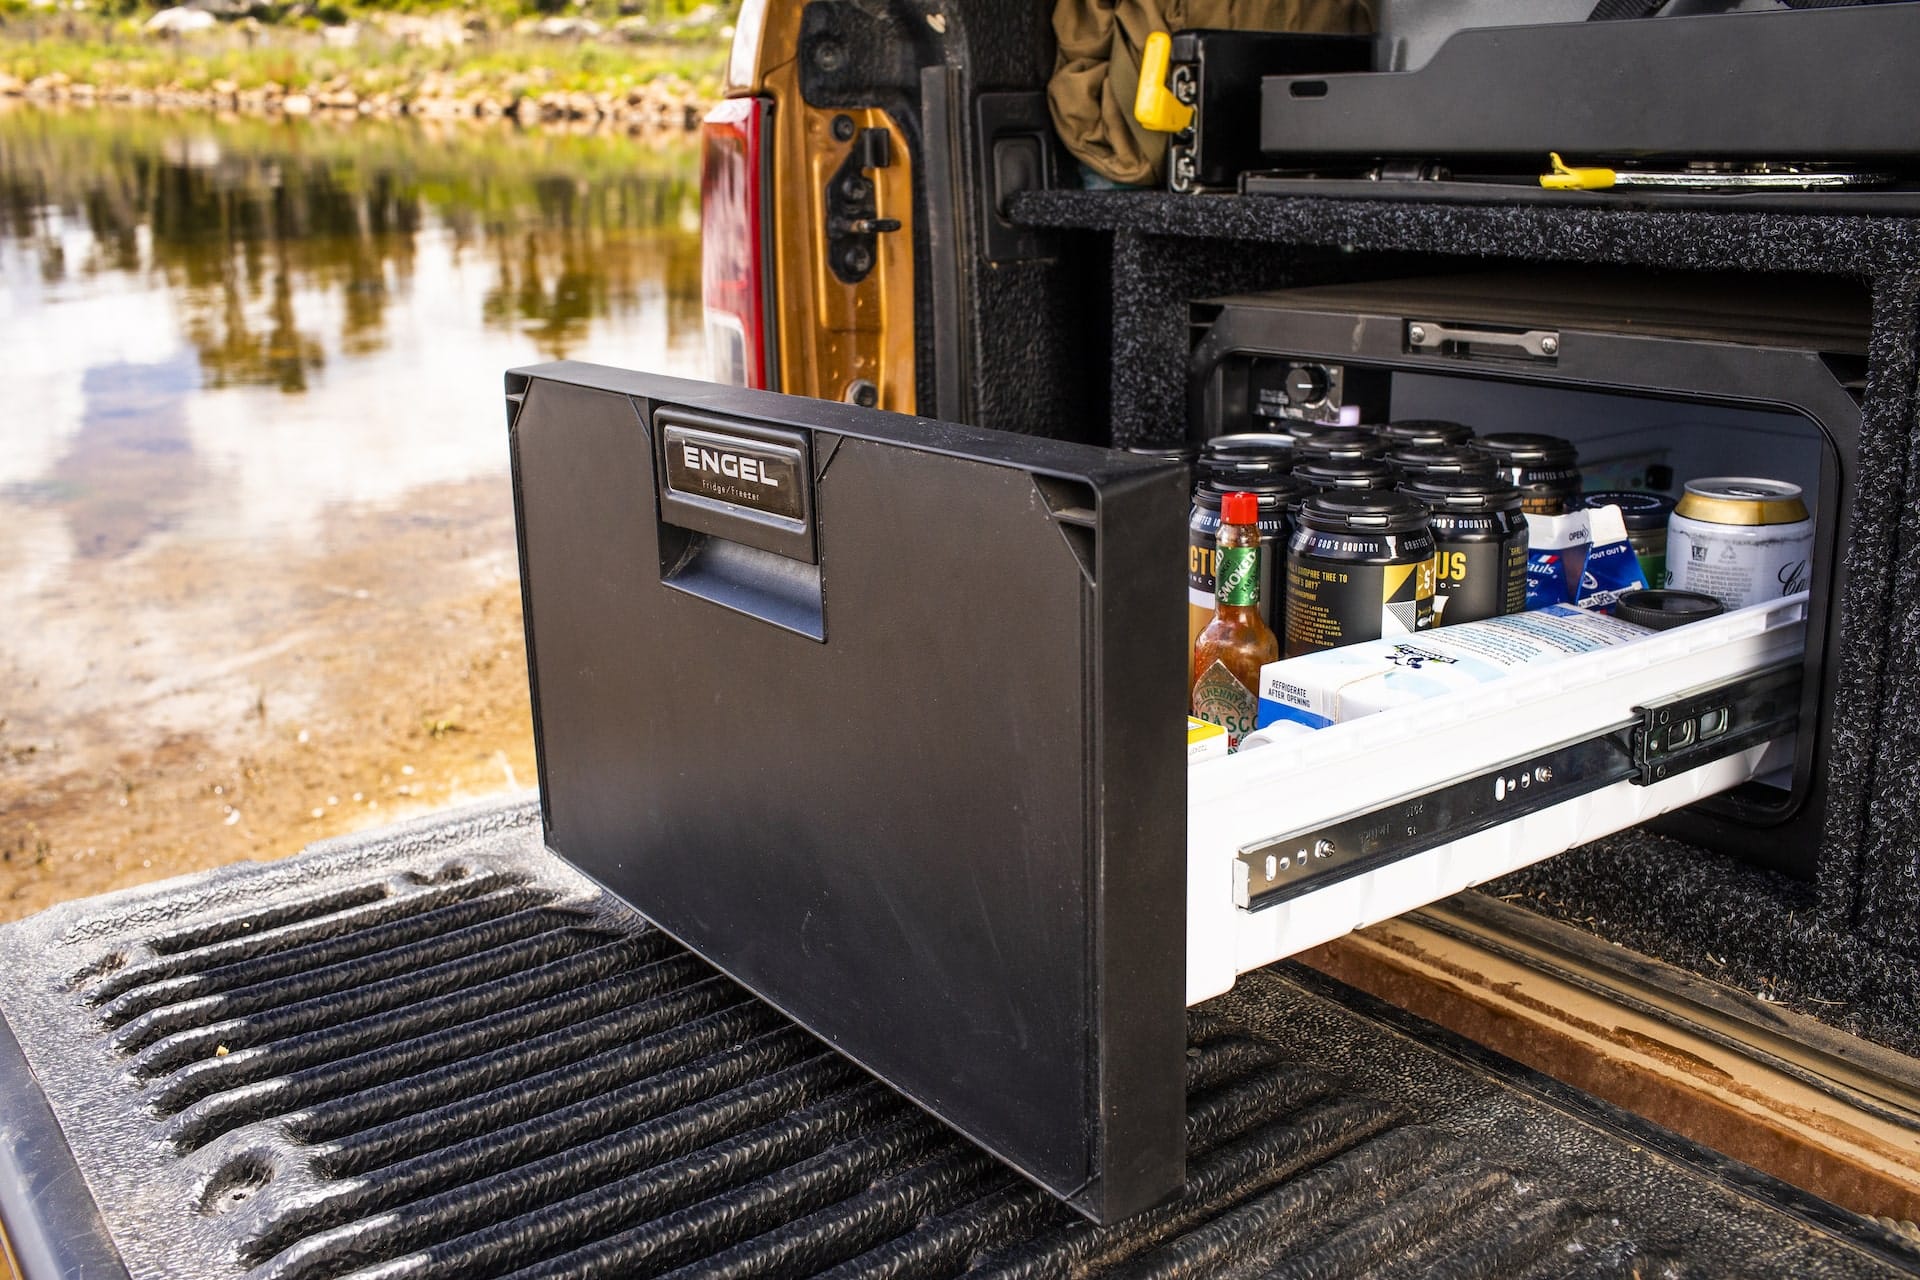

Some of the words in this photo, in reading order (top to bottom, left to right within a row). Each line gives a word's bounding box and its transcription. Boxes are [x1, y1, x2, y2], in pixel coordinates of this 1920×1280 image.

[682, 445, 779, 488] ENGEL
[701, 479, 760, 501] Fridge/Freezer
[1256, 520, 1282, 530] UNTRY
[1458, 519, 1493, 529] COUNTRY
[1568, 530, 1586, 541] OPEN
[1317, 538, 1340, 551] GOD'S
[1342, 542, 1380, 553] COUNTRY
[1435, 551, 1467, 581] US
[1526, 561, 1556, 575] auls
[1217, 549, 1258, 602] SMOKED
[1322, 571, 1337, 583] THEE
[1339, 573, 1348, 584] TO
[1271, 679, 1307, 698] REFRIGERATE
[1268, 687, 1285, 699] AFTER
[1286, 693, 1311, 708] OPENING
